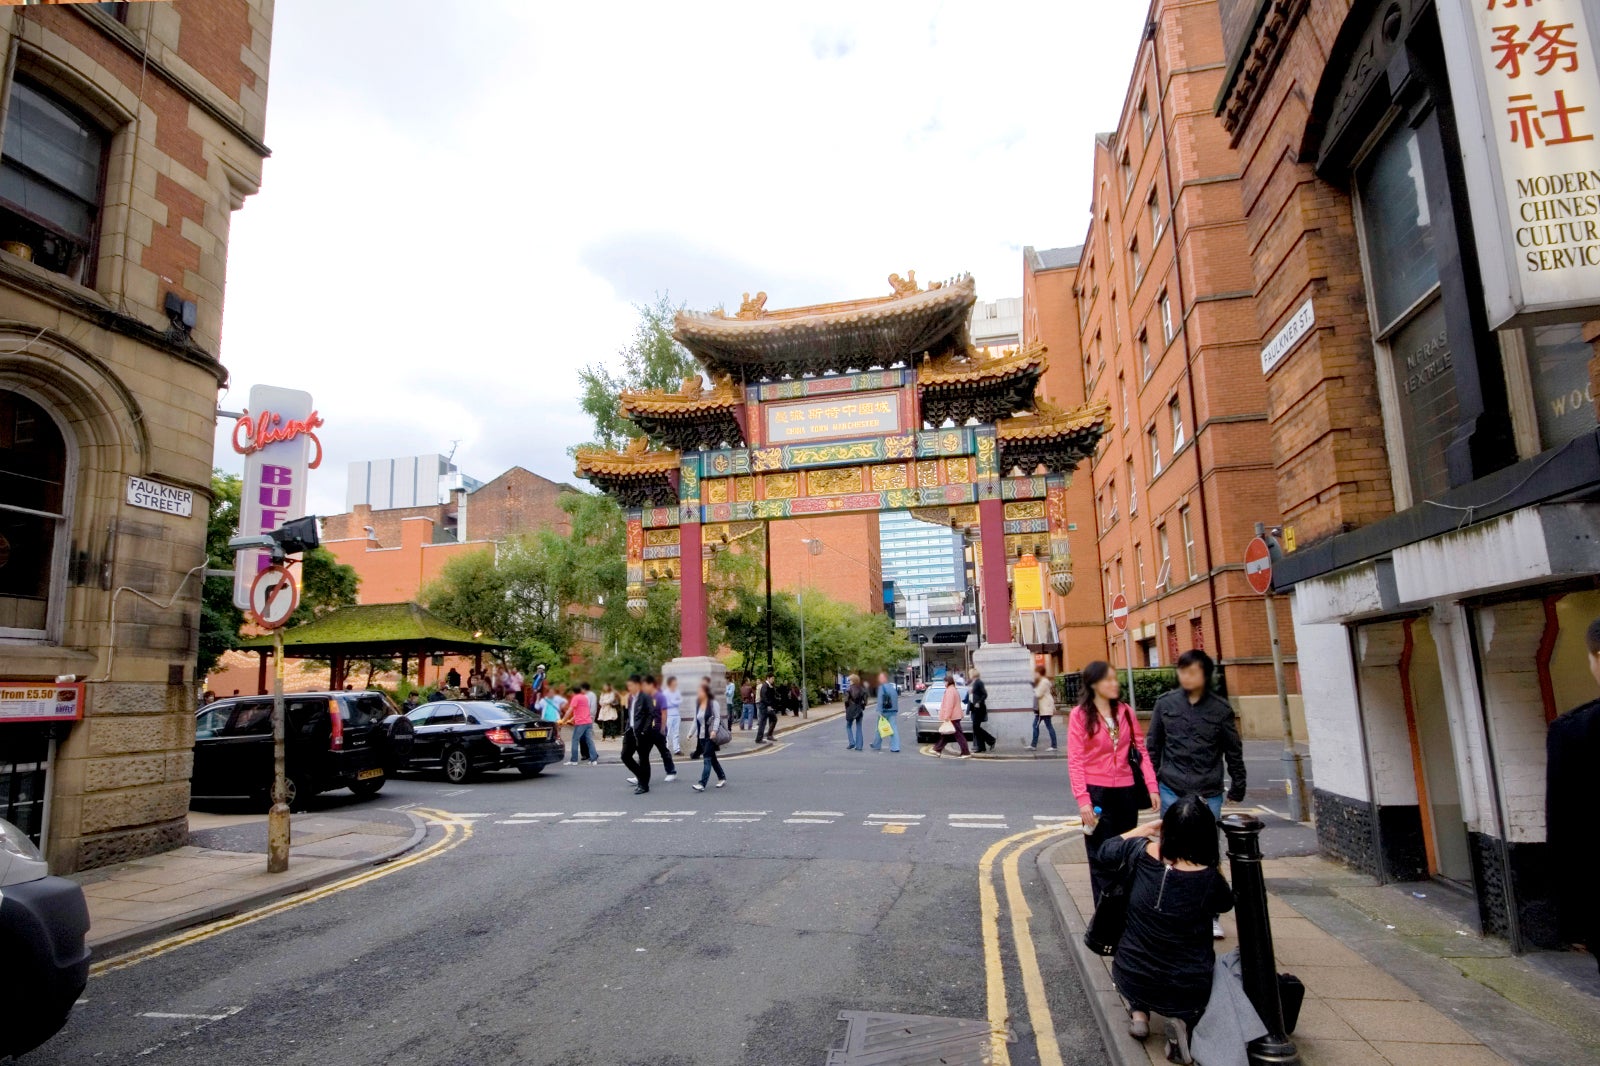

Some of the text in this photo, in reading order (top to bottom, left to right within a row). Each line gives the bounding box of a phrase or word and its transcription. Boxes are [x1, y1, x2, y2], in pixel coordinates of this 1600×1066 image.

[1487, 0, 1594, 149] 務社
[1516, 170, 1600, 198] MODERN
[1520, 195, 1600, 222] CHINES
[1263, 308, 1311, 364] FAULKNER ST.
[785, 426, 806, 435] CHINA
[832, 419, 880, 431] MANCHESTER
[130, 479, 191, 503] FAULKNER
[134, 492, 181, 512] STREET
[1, 689, 25, 700] from
